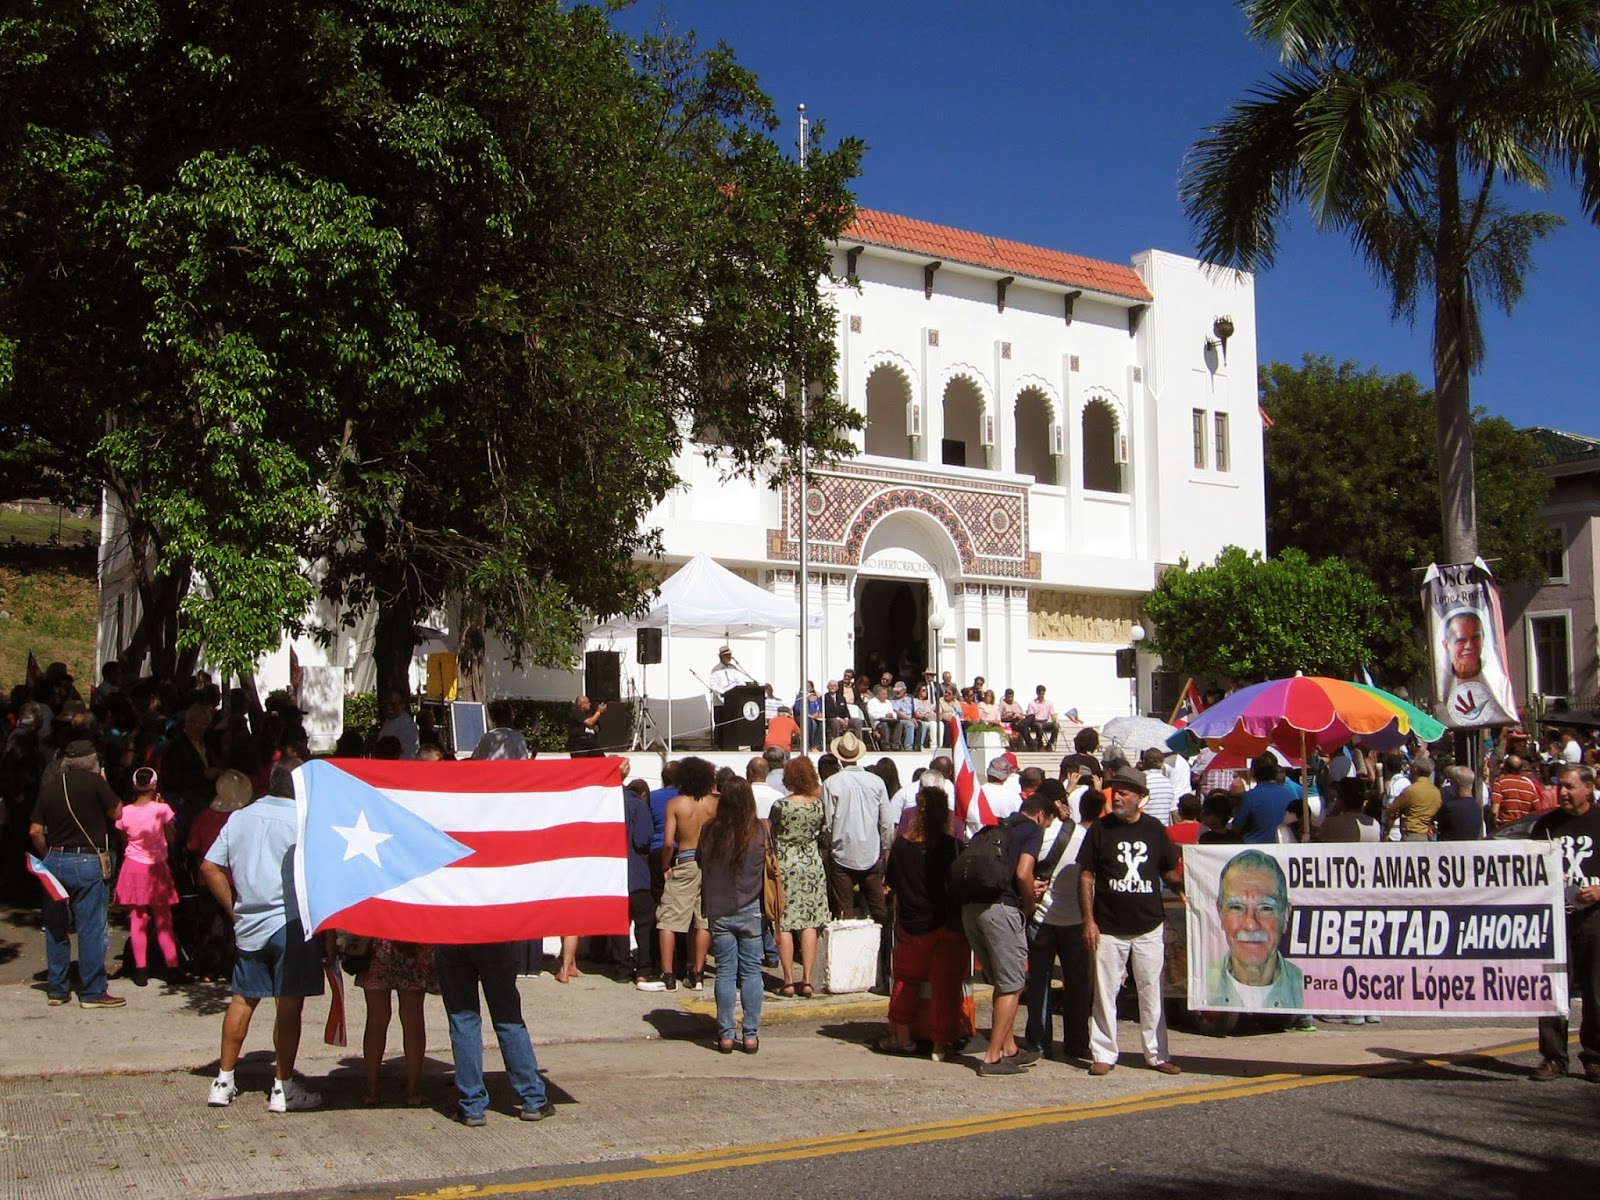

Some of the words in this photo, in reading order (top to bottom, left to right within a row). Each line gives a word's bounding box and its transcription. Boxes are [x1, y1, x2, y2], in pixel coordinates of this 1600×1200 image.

[1438, 567, 1477, 588] Osca
[1117, 841, 1148, 863] 32
[1560, 835, 1594, 858] 32
[1288, 856, 1365, 888] DELITO:
[1372, 856, 1432, 888] AMAR
[1438, 855, 1465, 888] SU
[1473, 854, 1549, 887] PATRIA
[1108, 878, 1153, 893] OSCAR
[1289, 910, 1450, 956] LIBERTAD
[1456, 909, 1550, 955] ¡AHORA!
[1303, 975, 1338, 990] Para
[1342, 965, 1405, 1000] Oscar
[1411, 966, 1476, 1010] López
[1482, 966, 1552, 1001] Rivera
